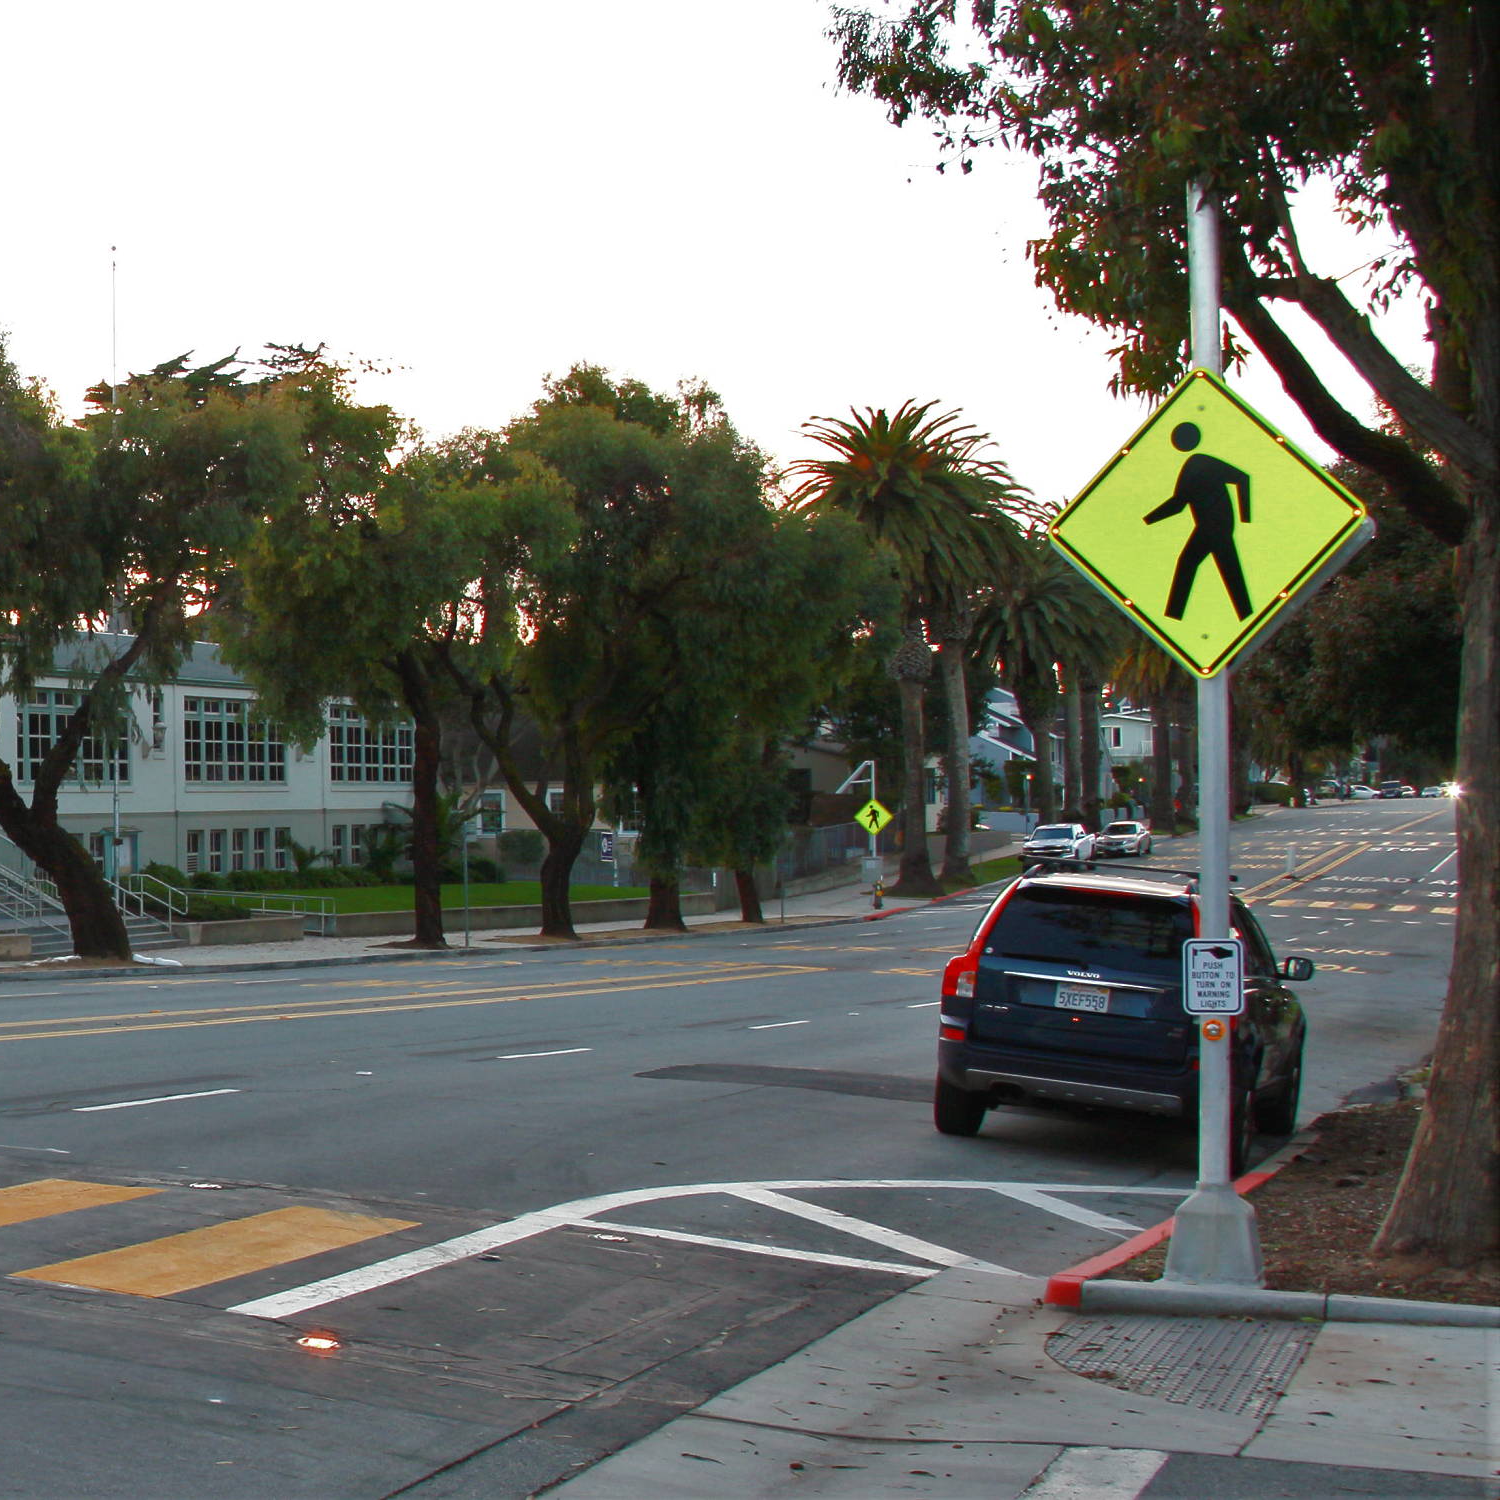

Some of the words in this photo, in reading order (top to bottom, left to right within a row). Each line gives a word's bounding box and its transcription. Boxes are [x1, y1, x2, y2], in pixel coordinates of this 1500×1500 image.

[1320, 875, 1412, 883] AHEAD
[1313, 886, 1378, 894] STOP
[1203, 961, 1223, 969] PUSH
[1067, 969, 1100, 979] VOLVO
[1191, 971, 1220, 979] BUTTON
[1225, 971, 1235, 979] TO
[1196, 980, 1216, 988] TURN
[1197, 990, 1231, 998] WARNING
[1058, 991, 1106, 1009] 5XEF558
[1200, 1000, 1227, 1008] LIGHTS
